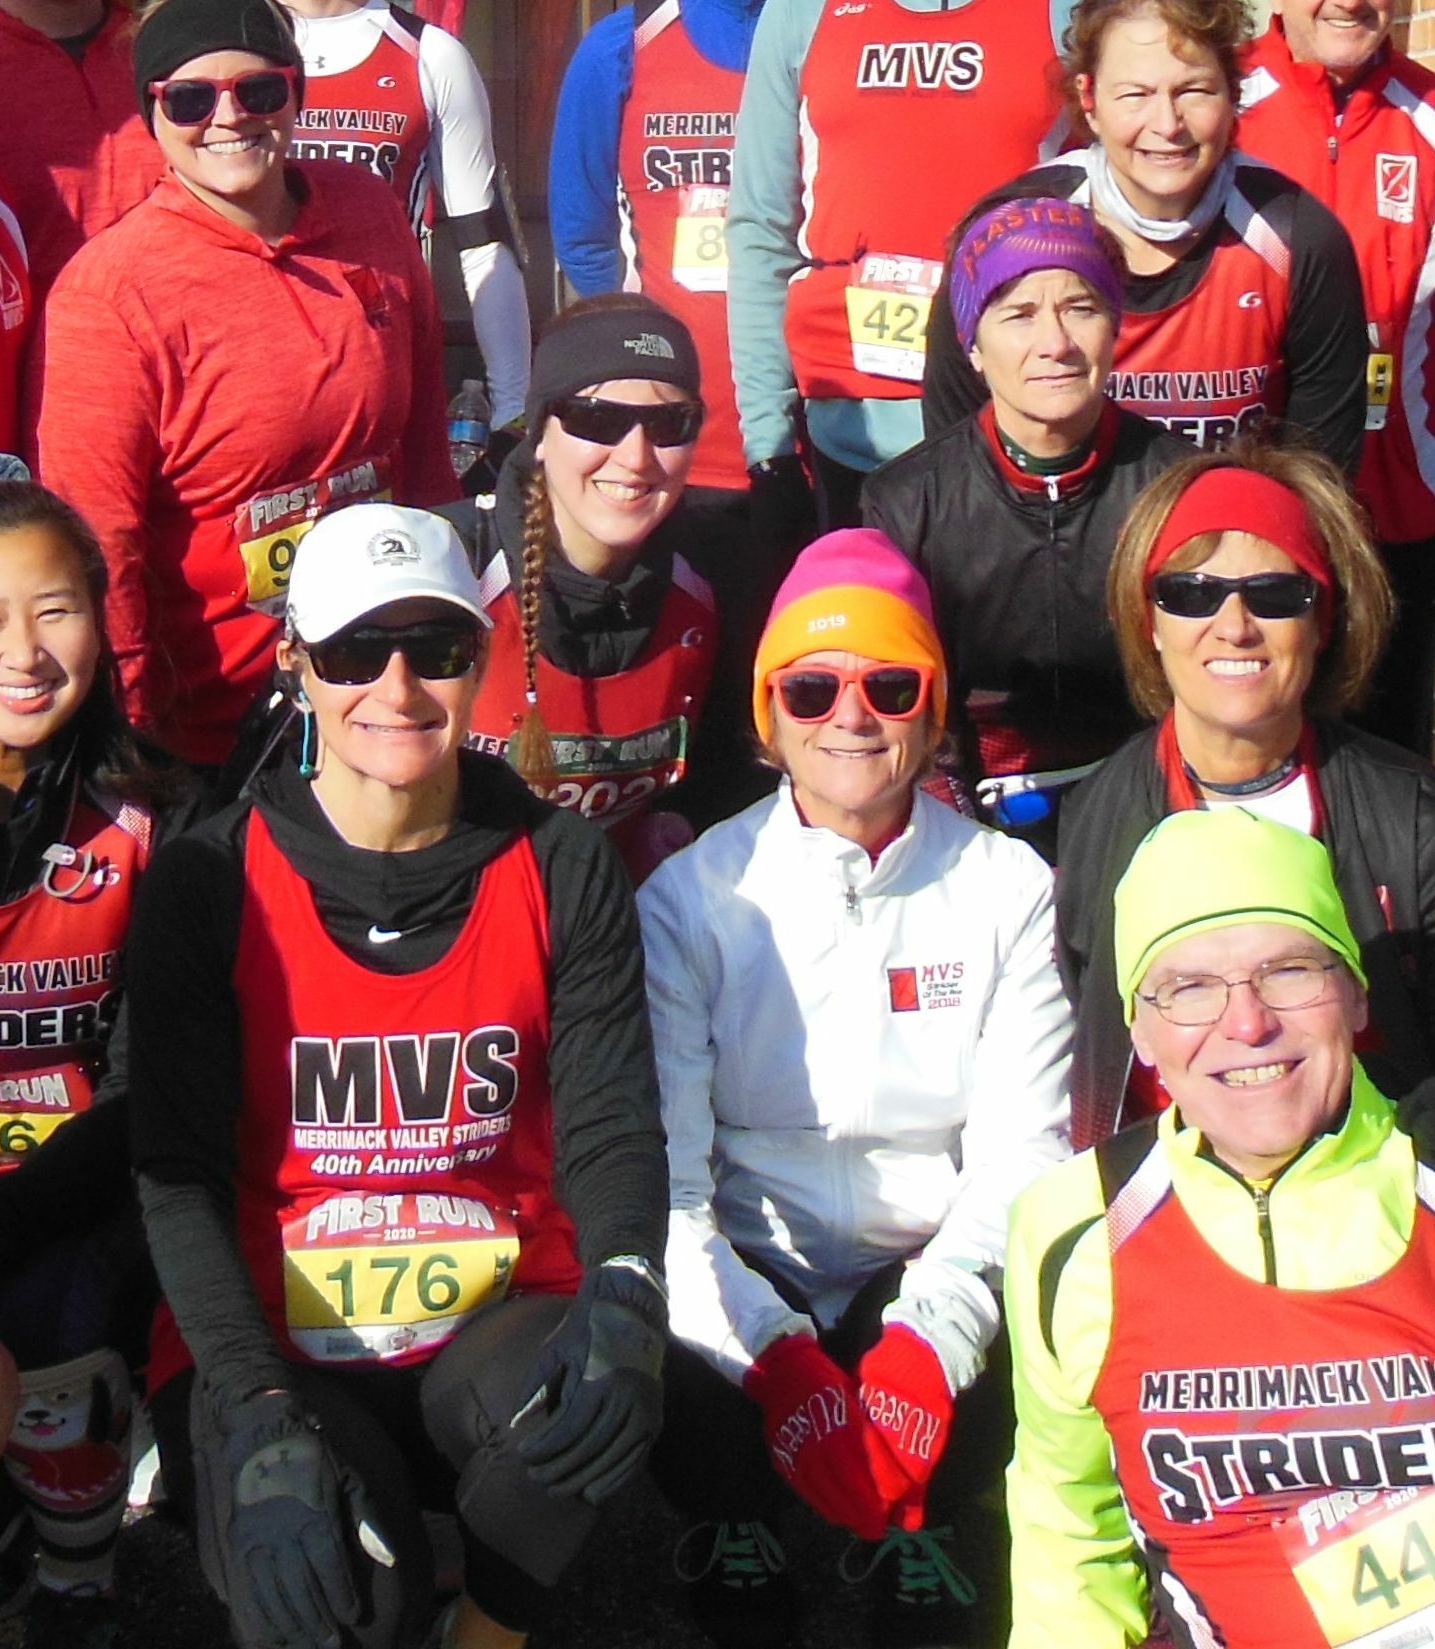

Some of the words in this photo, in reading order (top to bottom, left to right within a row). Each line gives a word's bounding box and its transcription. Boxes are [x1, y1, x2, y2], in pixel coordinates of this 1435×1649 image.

[857, 41, 985, 91] MVS
[333, 109, 408, 137] VALLEY
[865, 257, 926, 286] FIRST
[863, 300, 929, 343] 42
[1175, 365, 1270, 402] VALLEY
[249, 482, 318, 533] FIRST
[327, 460, 380, 499] RUN
[807, 612, 847, 633] 2019
[619, 727, 672, 762] RUN
[921, 961, 965, 983] MVS
[927, 996, 961, 1009] 2018
[289, 1024, 521, 1128] MVS
[293, 1125, 388, 1151] MERRIMACK
[390, 1126, 449, 1151] VALLEY
[452, 1115, 512, 1147] STRIDERS
[310, 1154, 362, 1177] 40th
[366, 1143, 497, 1176] Anniversary
[305, 1195, 404, 1242] FIRST
[415, 1194, 497, 1232] RUN
[383, 1229, 417, 1242] 2020
[325, 1253, 462, 1319] 176
[1139, 1358, 1368, 1414] MERRIMACK
